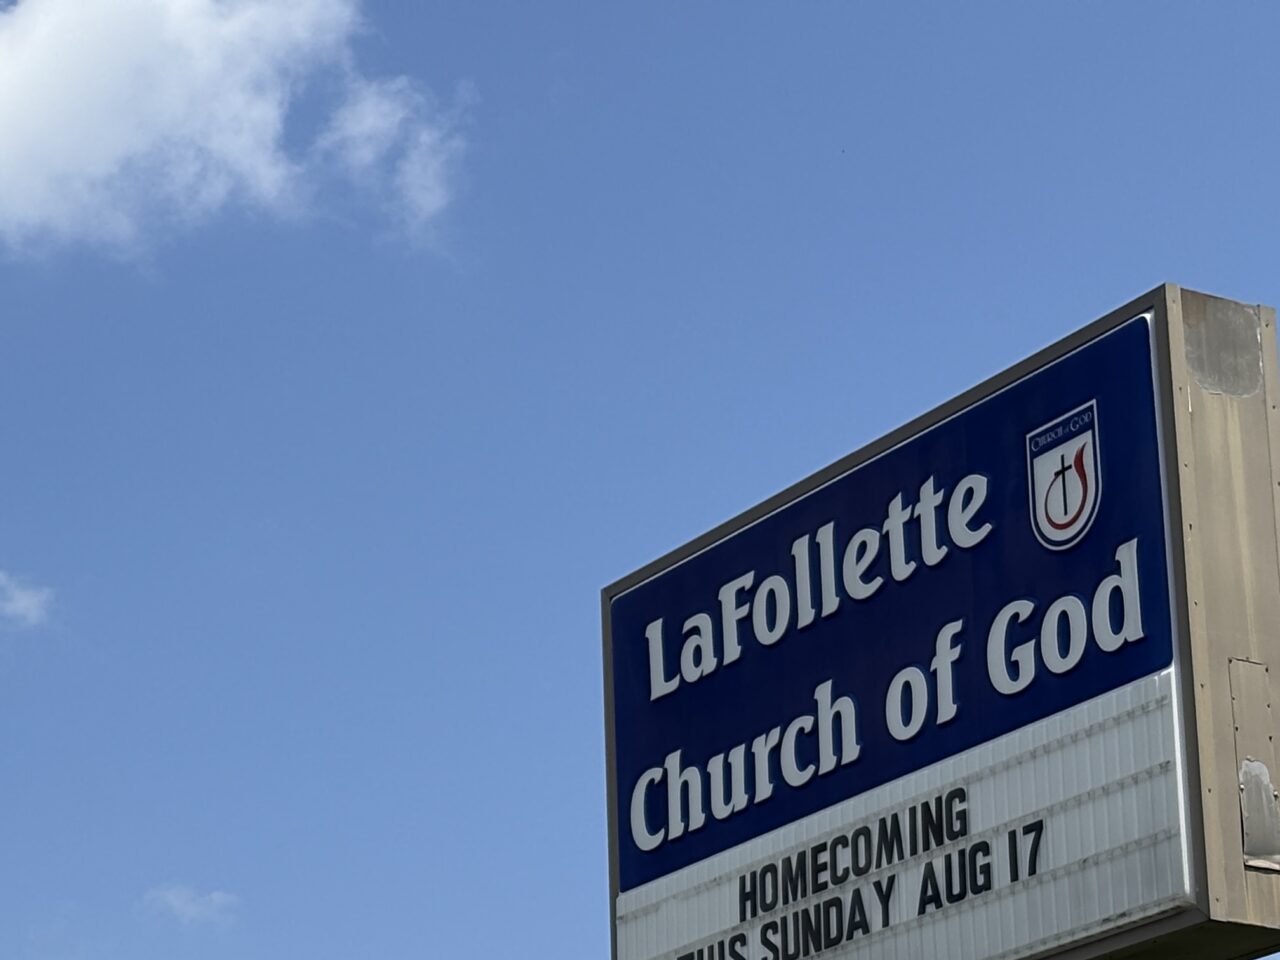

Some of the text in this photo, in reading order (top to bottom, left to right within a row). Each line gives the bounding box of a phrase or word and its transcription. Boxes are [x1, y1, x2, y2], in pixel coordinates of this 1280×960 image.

[645, 474, 993, 702] LaFollette
[630, 537, 1145, 852] Church of God
[738, 787, 968, 923] HOMECOMING
[918, 840, 992, 917] AUG
[1007, 818, 1044, 884] 17
